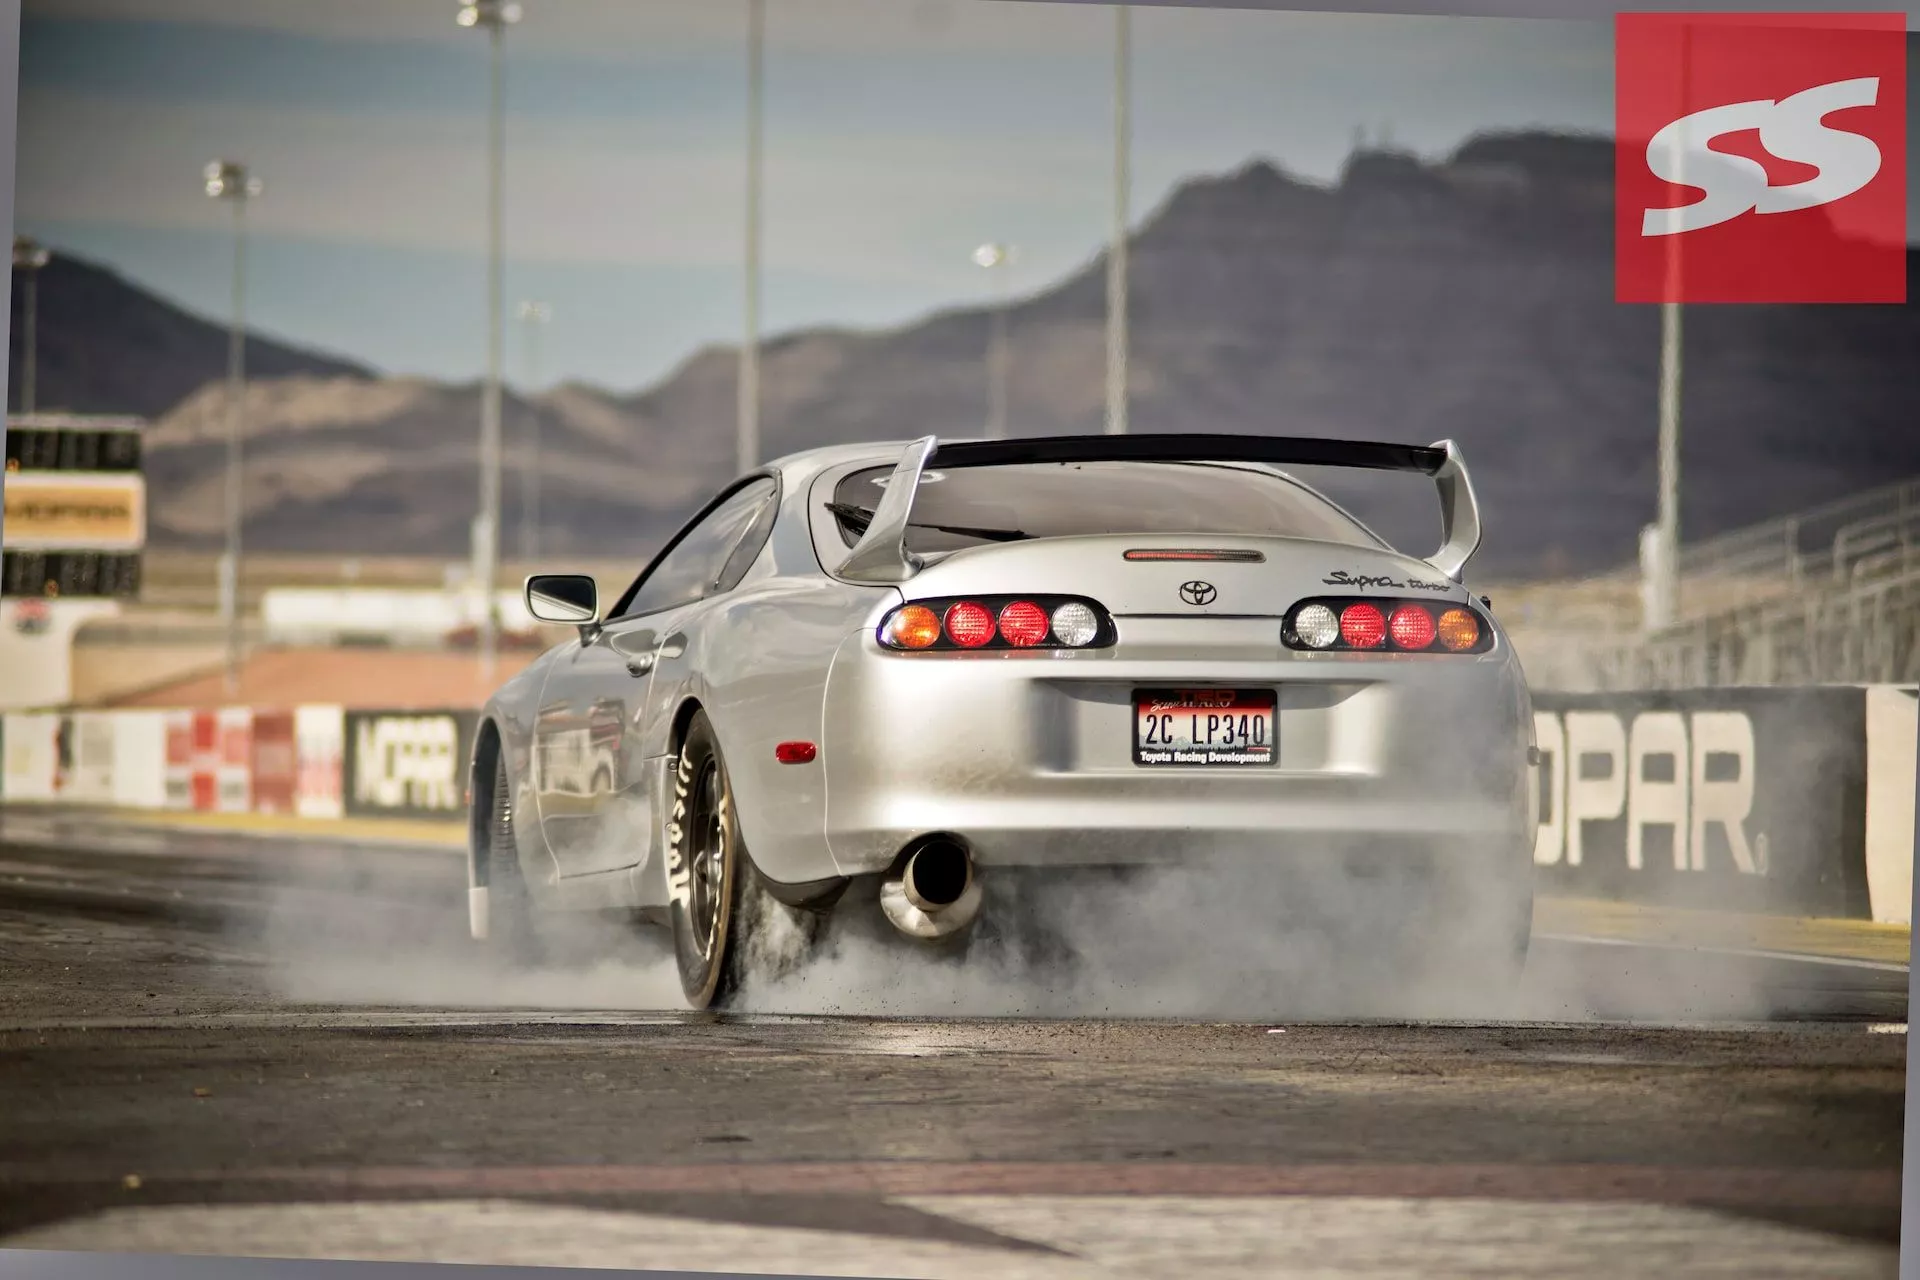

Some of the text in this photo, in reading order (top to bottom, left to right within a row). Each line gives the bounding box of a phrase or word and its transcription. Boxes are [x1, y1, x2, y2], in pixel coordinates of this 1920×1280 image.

[1322, 571, 1450, 592] Supra turbo
[1145, 714, 1265, 745] 2C LP340
[1140, 752, 1271, 764] Toyota Racing Development
